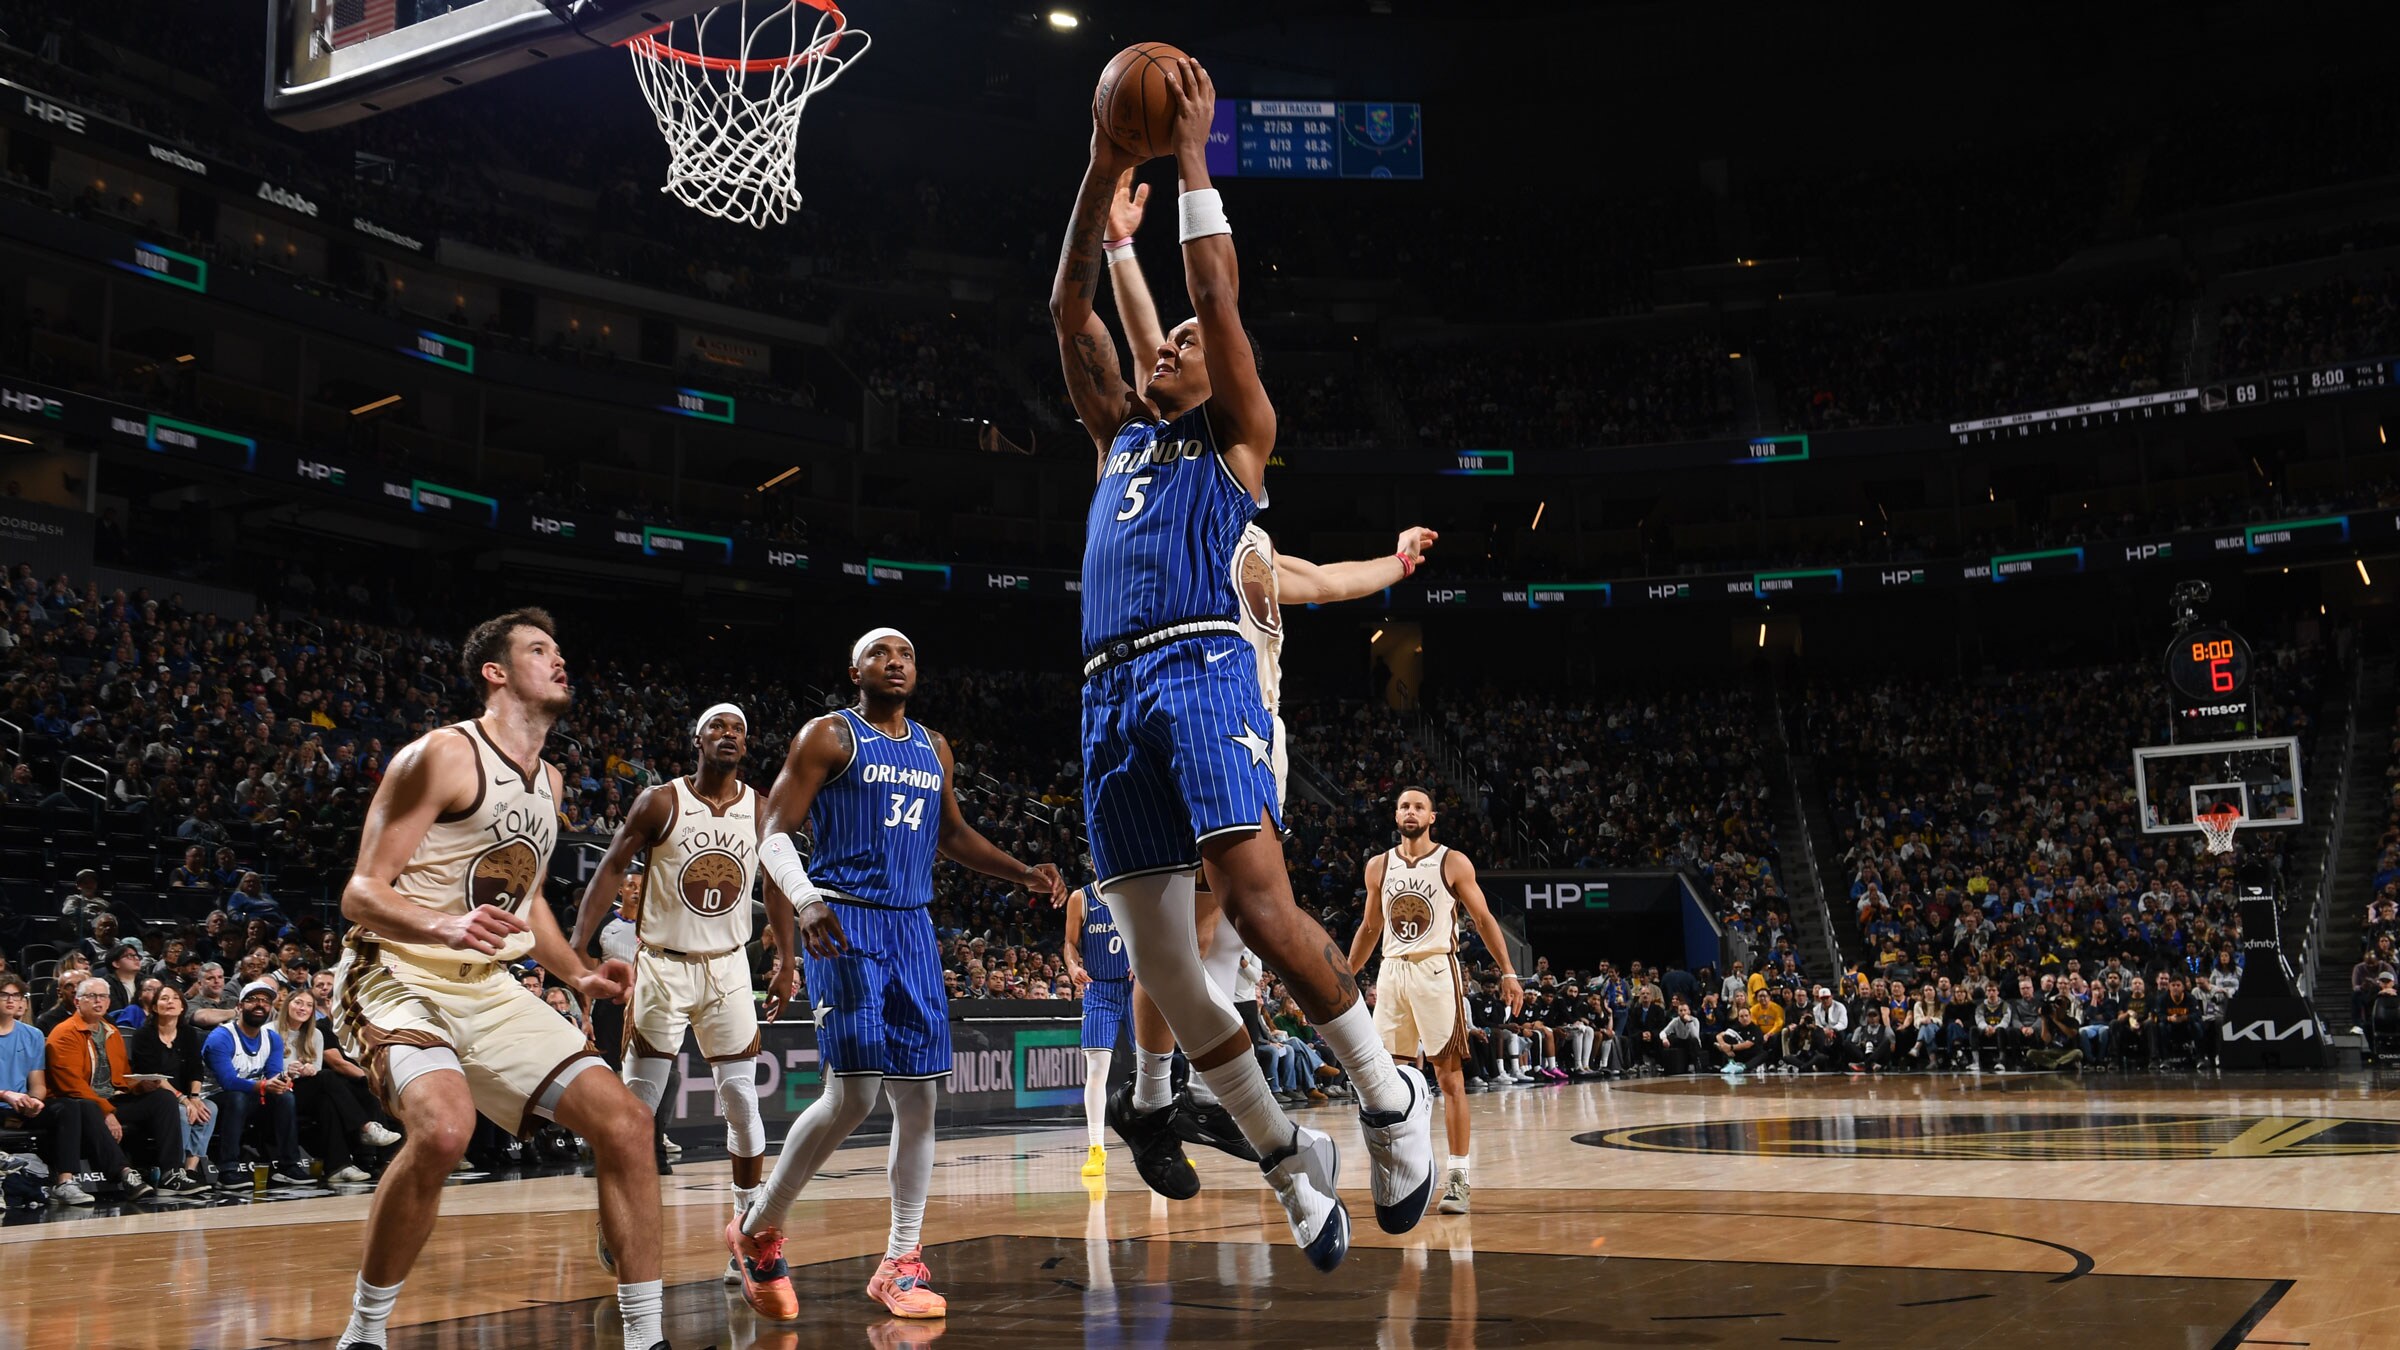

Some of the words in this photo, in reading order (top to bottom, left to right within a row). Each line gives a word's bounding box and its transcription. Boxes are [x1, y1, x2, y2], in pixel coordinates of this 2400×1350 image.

[24, 95, 87, 134] HPE
[1261, 103, 1281, 114] SHOT
[1286, 103, 1322, 115] TRACKER
[148, 143, 208, 176] verizon
[256, 181, 319, 218] Adobe
[2311, 369, 2345, 388] 8:00
[2236, 384, 2256, 403] 69
[1, 387, 64, 421] HPE
[1749, 444, 1776, 457] YOUR
[297, 458, 347, 487] HPE
[1458, 456, 1484, 470] YOUR
[1116, 476, 1152, 521] 5
[531, 514, 577, 539] HPE
[2215, 536, 2244, 550] UNLOCK
[2254, 531, 2291, 546] AMBITION
[767, 550, 809, 570] HPE
[2126, 542, 2173, 562] HPE
[1882, 569, 1925, 586] HPE
[1964, 566, 1991, 579] UNLOCK
[1999, 561, 2032, 574] AMBITION
[988, 573, 1030, 590] HPE
[1727, 581, 1753, 594] UNLOCK
[1761, 579, 1793, 592] AMBITION
[1426, 589, 1467, 604] HPE
[1502, 591, 1527, 603] UNLOCK
[1534, 591, 1565, 603] AMBITION
[1648, 583, 1690, 600] HPE
[2191, 639, 2234, 662] 8:00
[2210, 658, 2234, 692] 6
[2199, 703, 2247, 717] TISSOT
[493, 802, 508, 818] The
[884, 793, 925, 831] 34
[485, 808, 553, 856] TOWN
[682, 826, 695, 837] The
[678, 829, 751, 860] TOWN
[1385, 878, 1438, 898] TOWN
[1525, 883, 1609, 909] HPE
[702, 888, 722, 910] 10
[1400, 921, 1418, 938] 30
[1108, 936, 1122, 954] 0
[2244, 938, 2276, 950] xfinity
[2222, 1019, 2314, 1042] KIA
[946, 1050, 1013, 1094] UNLOCK
